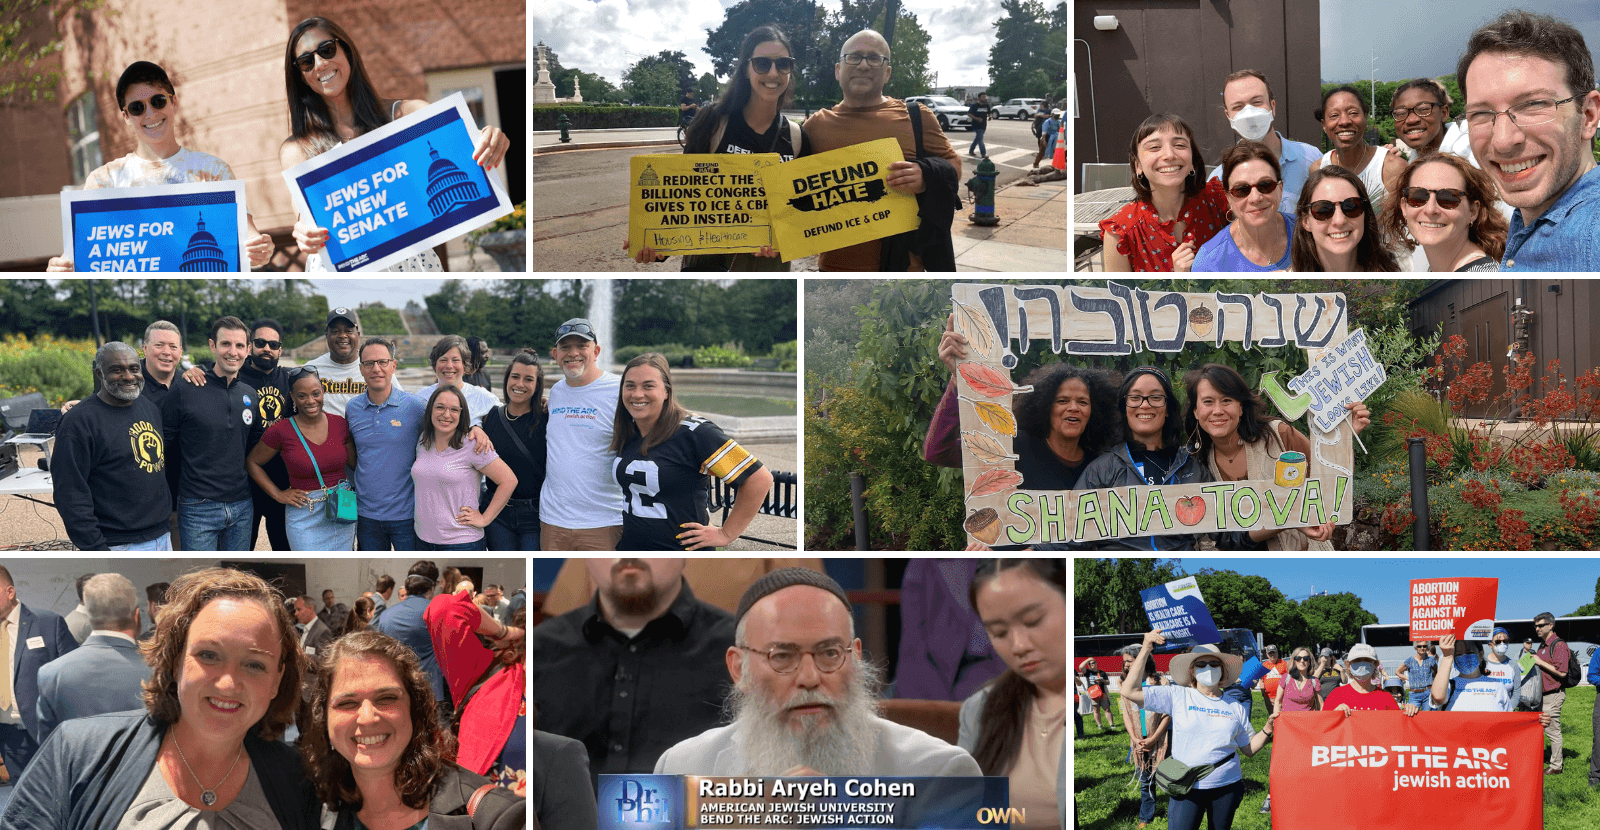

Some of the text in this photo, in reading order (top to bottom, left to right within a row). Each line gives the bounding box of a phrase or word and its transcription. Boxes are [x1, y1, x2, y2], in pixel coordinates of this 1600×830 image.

[324, 161, 409, 211] JEWS FOR
[663, 174, 754, 186] REDIRECT THE
[792, 161, 879, 194] DEFUND
[641, 187, 766, 199] BILLIONS CONGRES
[811, 182, 869, 209] HATE
[332, 189, 387, 228] A NEW
[644, 201, 685, 212] GIVES
[689, 201, 707, 212] TO
[711, 200, 730, 211] ICE
[735, 200, 743, 210] &
[337, 201, 408, 244] SENATE
[660, 213, 753, 225] AND INSTEAD:
[804, 209, 891, 238] DEFUND ICE & CBP
[87, 221, 174, 241] JEWS FOR
[653, 232, 693, 247] Housing
[88, 240, 148, 258] A NEW
[89, 257, 160, 272] SENATE
[1216, 291, 1346, 350] שנה
[1289, 330, 1364, 392] THIS IS WHAT
[1308, 346, 1374, 411] JEWISH
[1317, 365, 1385, 429] LOOKS LIKE!
[1006, 476, 1348, 544] SHANA TOVA!
[1412, 581, 1459, 595] ABORTION
[1412, 594, 1457, 607] BANS ARE
[1147, 611, 1155, 621] IS
[1154, 608, 1171, 620] HEALTH
[1182, 616, 1191, 626] IS
[1190, 614, 1197, 624] A
[1412, 606, 1466, 619] AGAINST MY
[1412, 619, 1455, 631] RELIGION.
[1311, 745, 1508, 770] BEND THE ARC
[1393, 770, 1510, 791] jewish action
